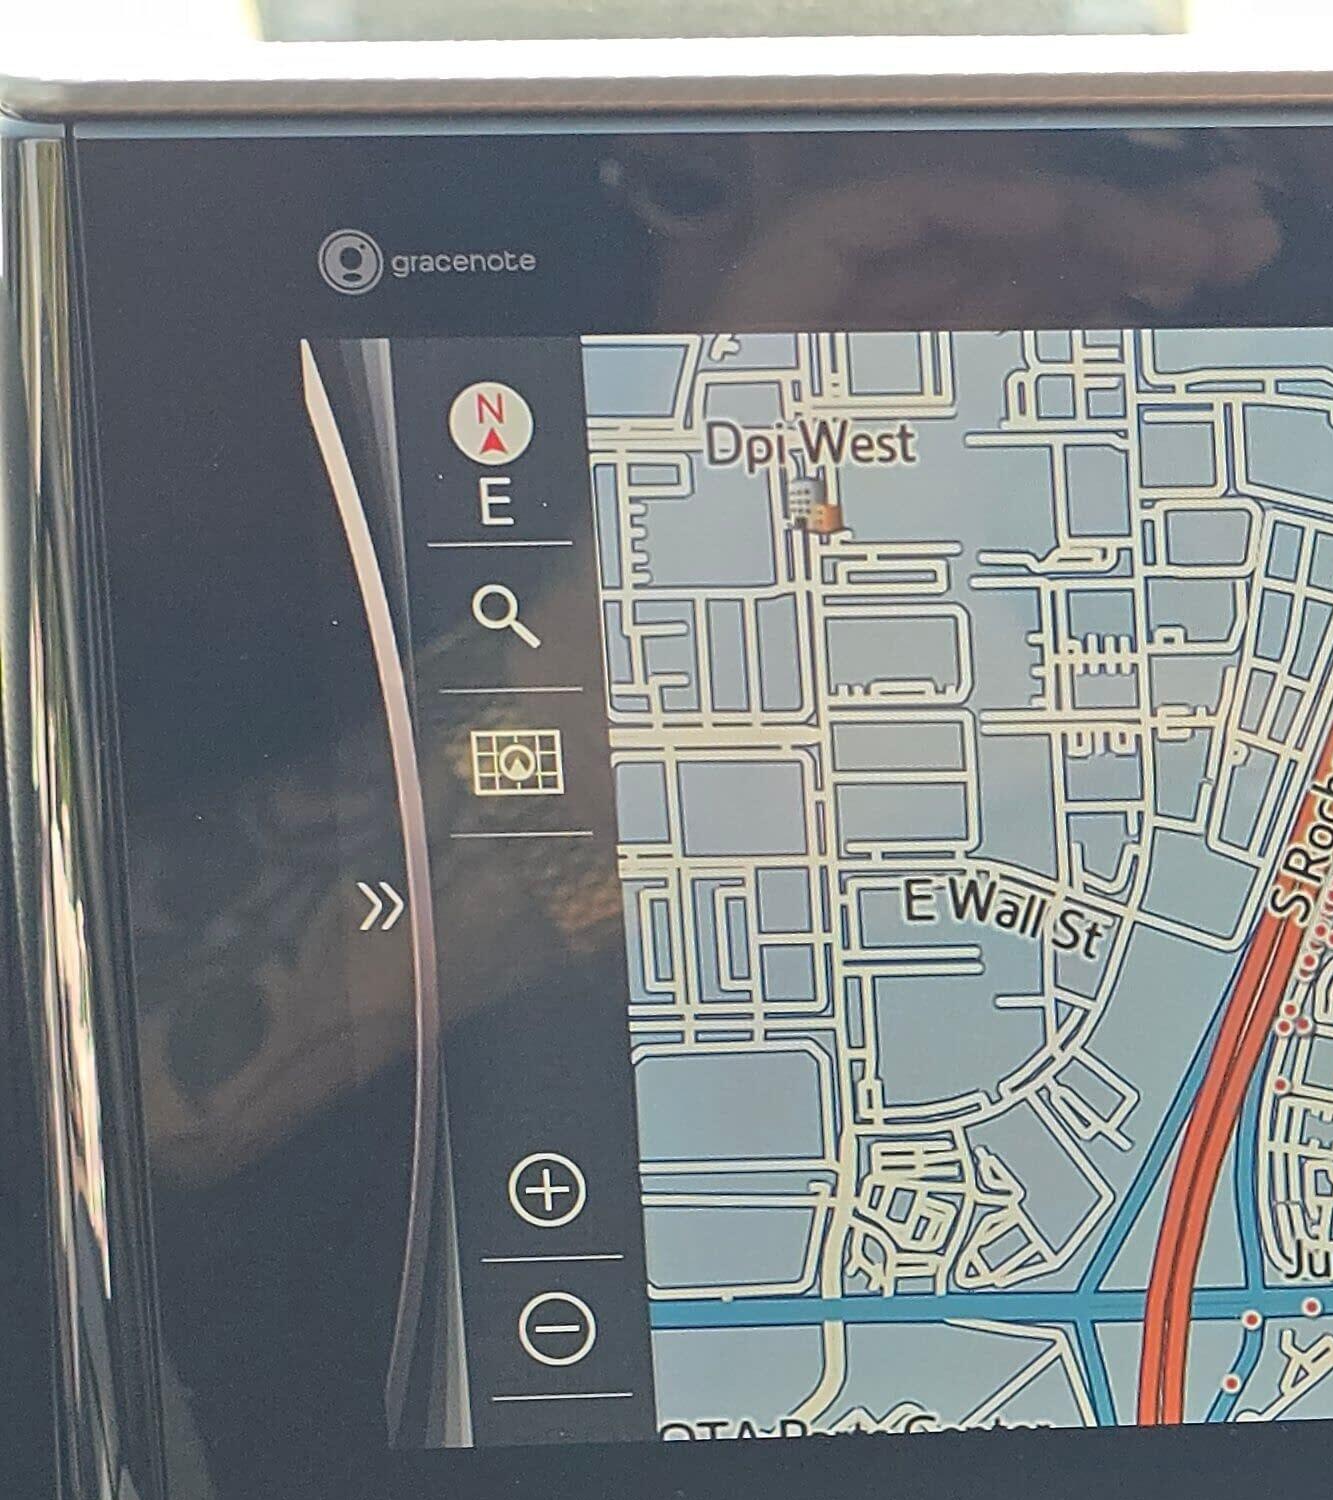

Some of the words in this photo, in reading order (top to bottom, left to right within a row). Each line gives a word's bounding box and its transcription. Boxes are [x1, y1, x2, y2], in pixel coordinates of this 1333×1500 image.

[391, 249, 538, 278] gracenote
[706, 421, 788, 472] Dpi
[798, 420, 917, 464] West
[905, 878, 935, 921] E
[949, 876, 1047, 939] Wall
[1051, 908, 1103, 959] St
